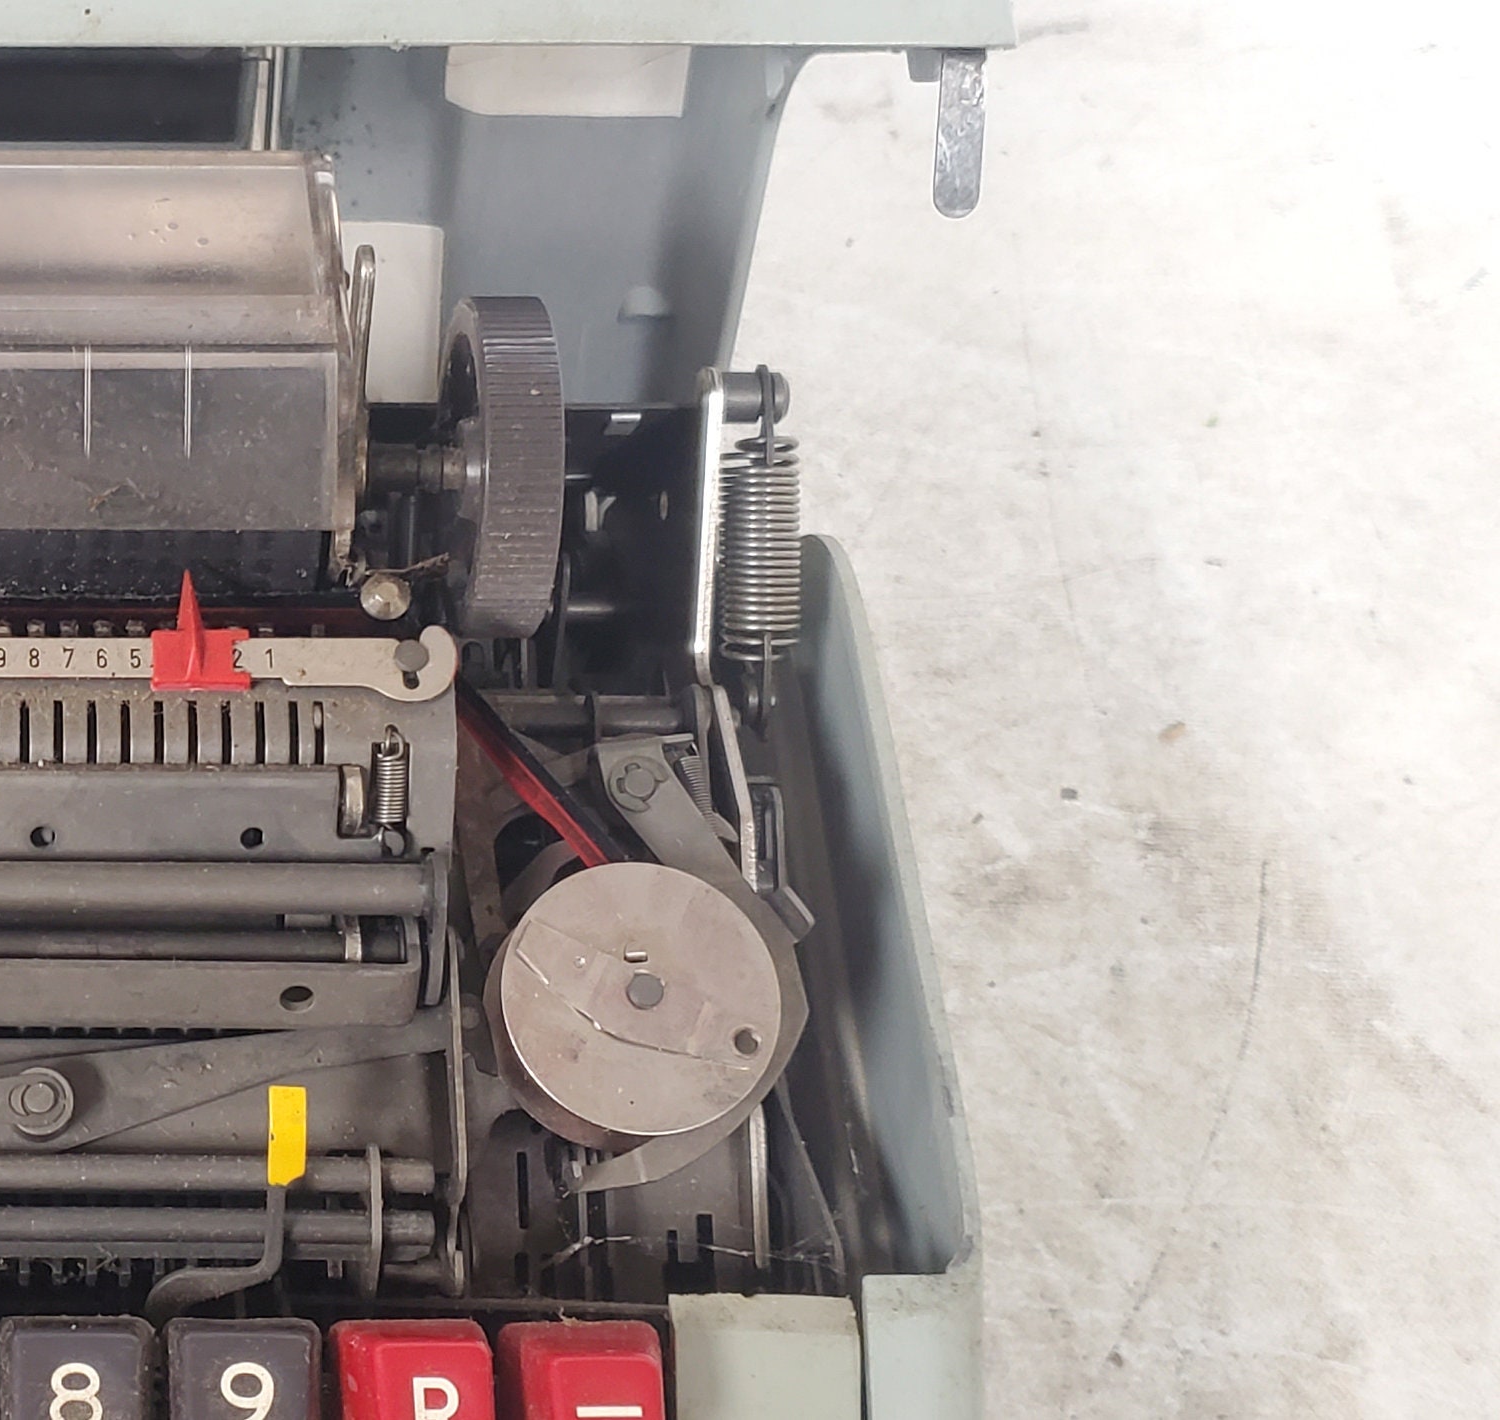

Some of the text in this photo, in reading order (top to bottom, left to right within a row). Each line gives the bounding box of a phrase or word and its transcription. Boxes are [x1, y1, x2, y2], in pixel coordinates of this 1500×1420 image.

[29, 648, 40, 668] 8
[62, 648, 75, 668] 7
[96, 648, 108, 668] 6
[130, 648, 141, 668] 5
[49, 1362, 103, 1420] 8
[220, 1361, 275, 1420] 9
